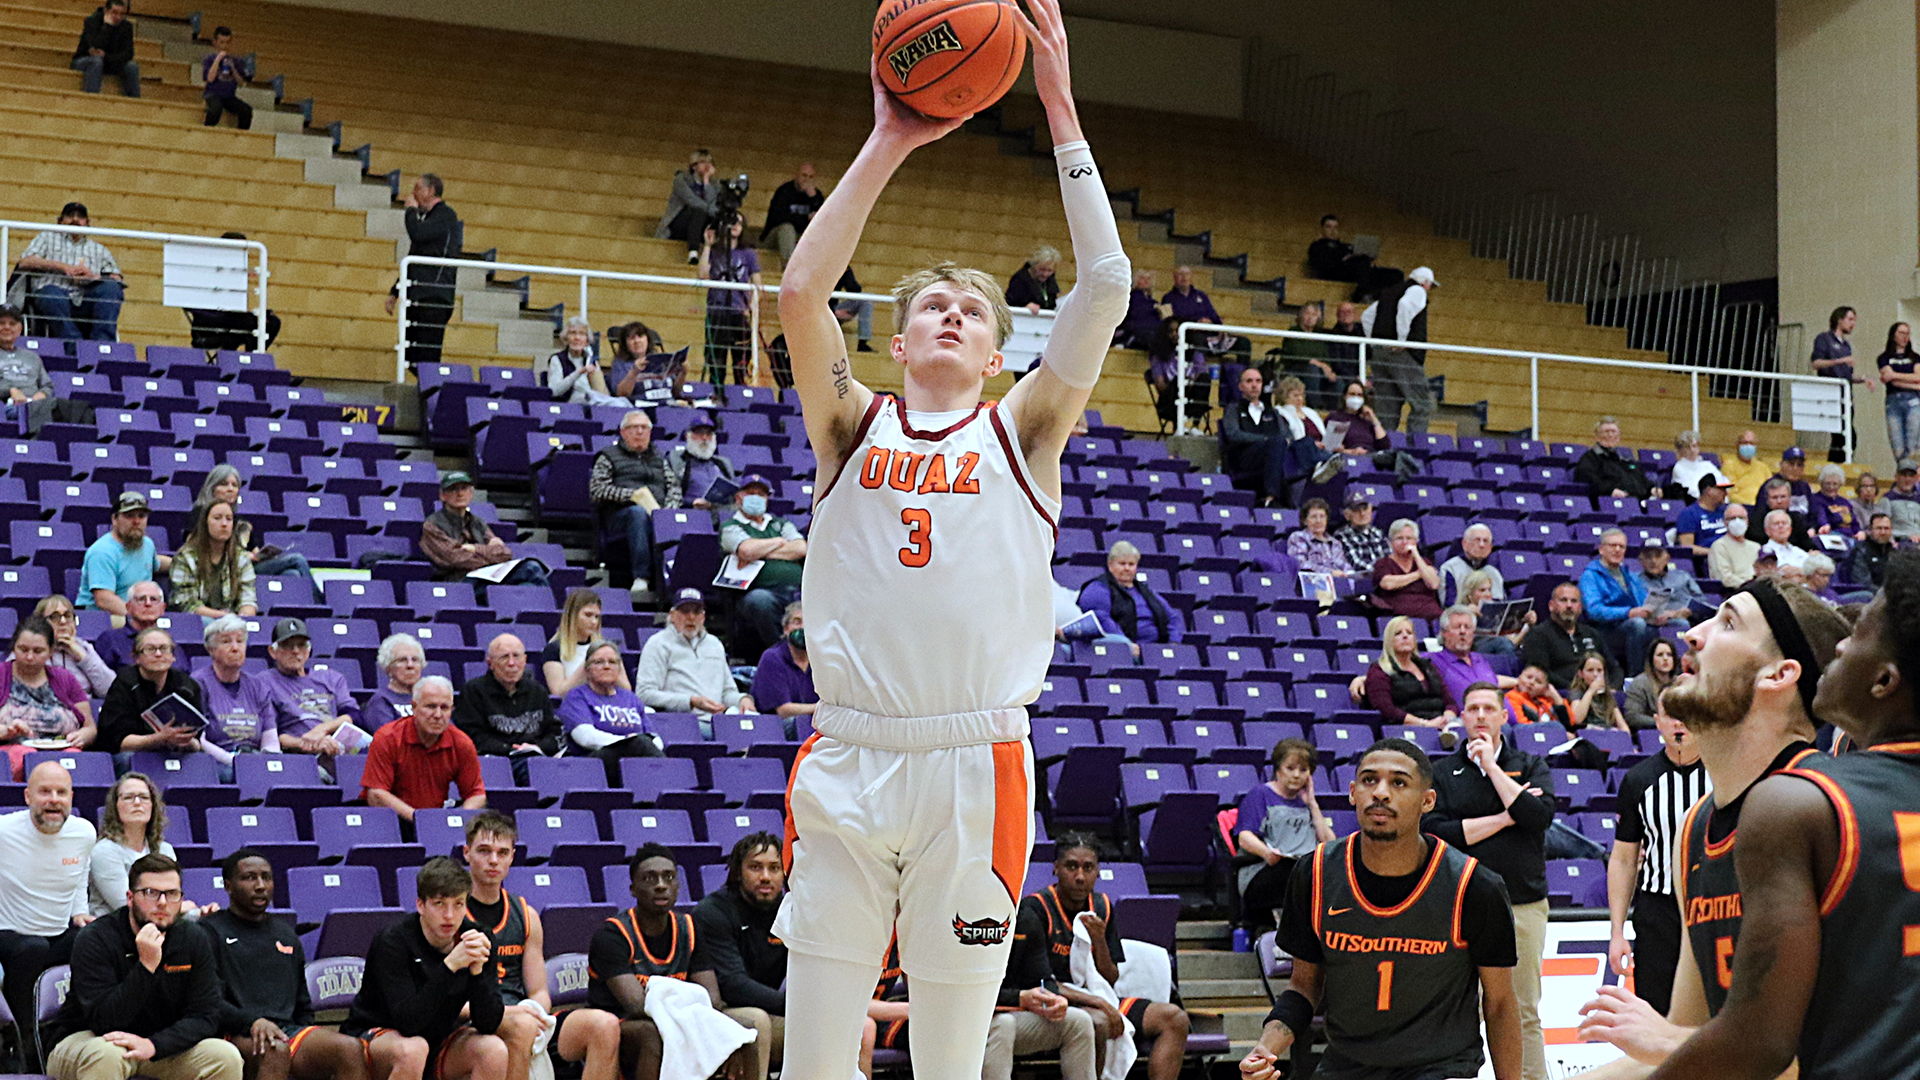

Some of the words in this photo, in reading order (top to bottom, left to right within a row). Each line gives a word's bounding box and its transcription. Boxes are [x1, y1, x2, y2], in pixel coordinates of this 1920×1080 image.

[887, 21, 964, 86] NAIA
[375, 405, 390, 425] 7
[859, 446, 981, 495] OUAZ
[898, 508, 932, 568] 3
[962, 926, 1006, 941] SPIRIT
[1377, 960, 1395, 1011] 1
